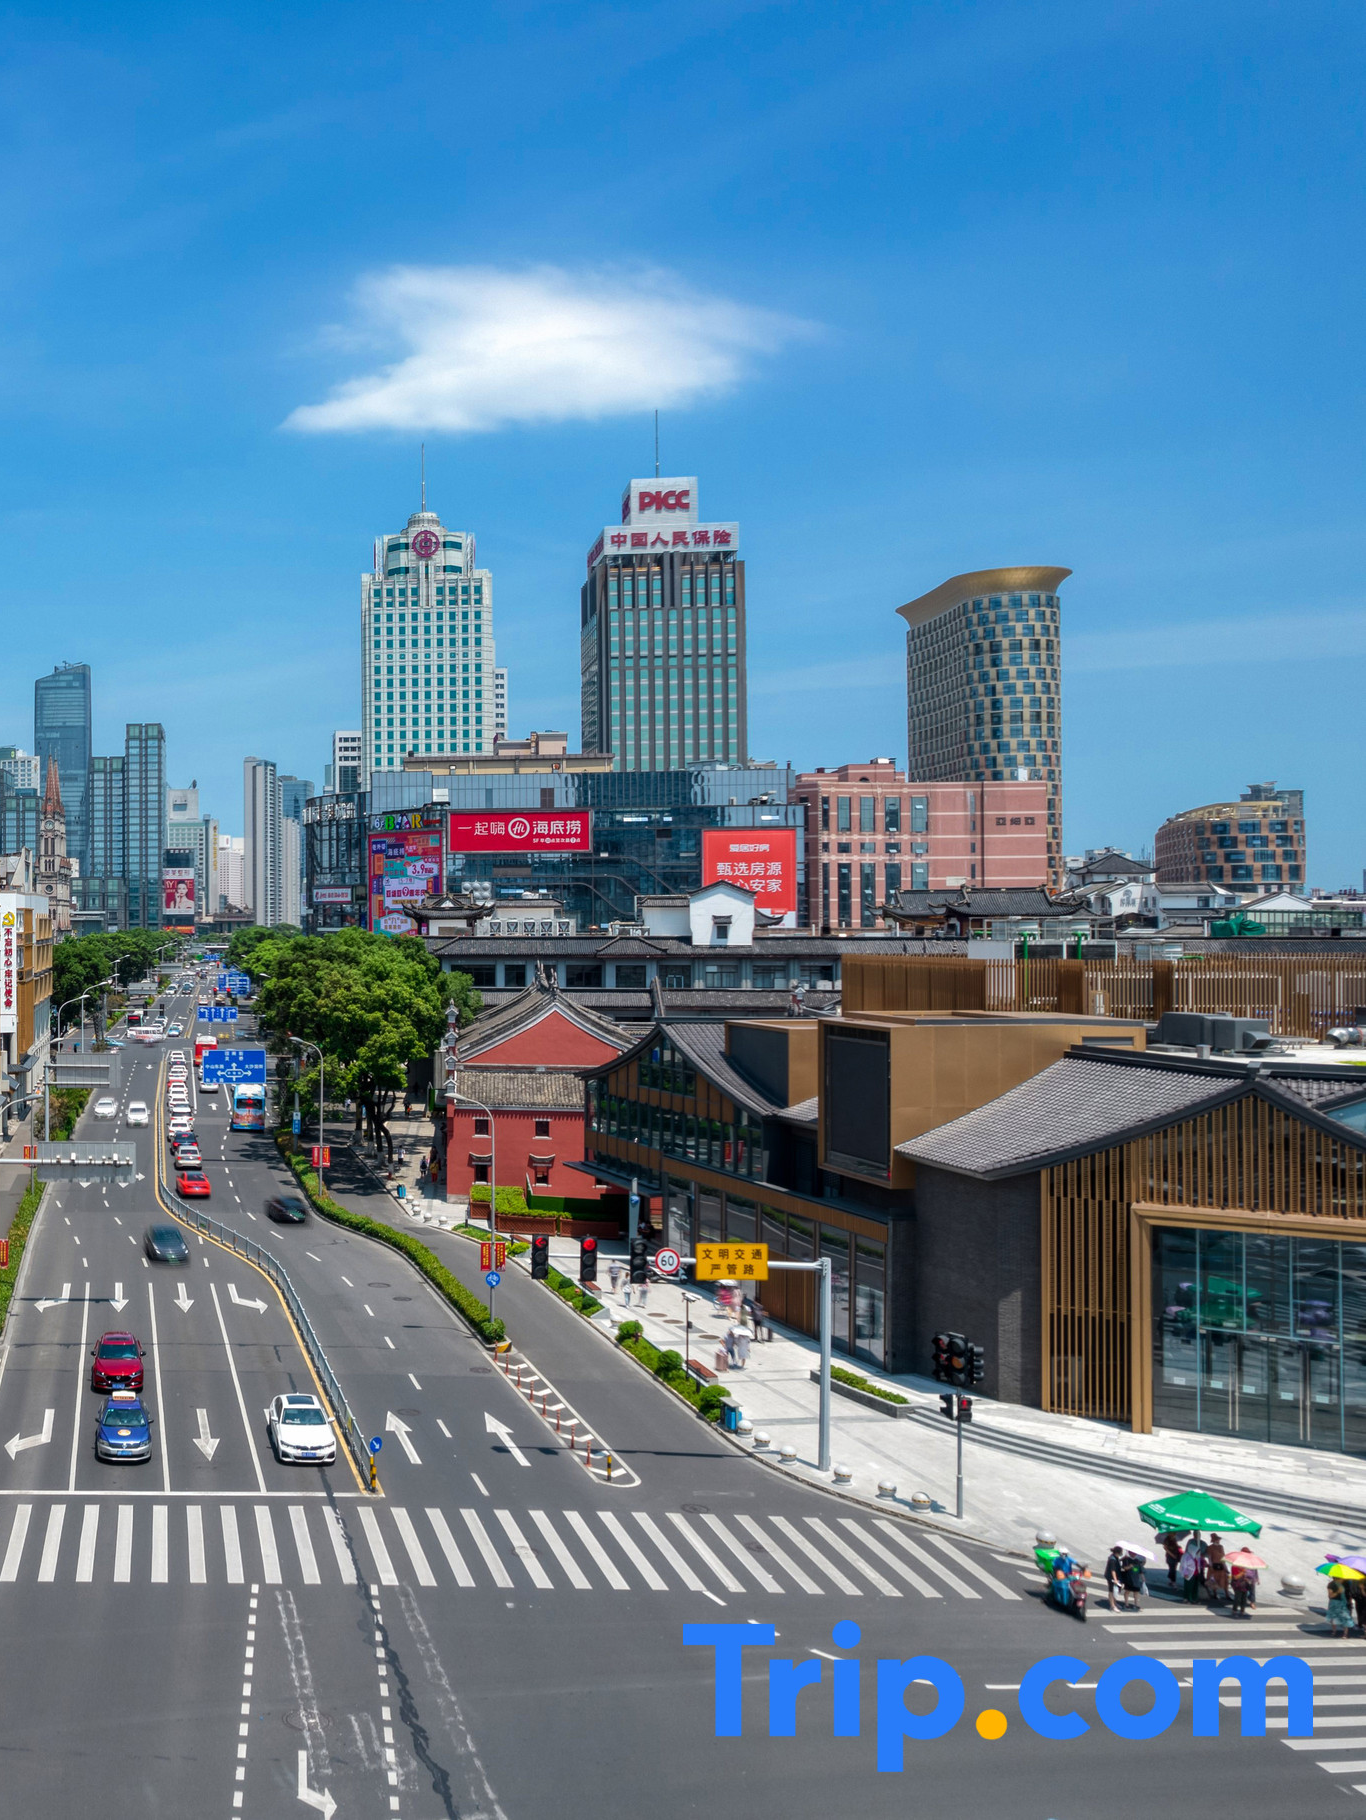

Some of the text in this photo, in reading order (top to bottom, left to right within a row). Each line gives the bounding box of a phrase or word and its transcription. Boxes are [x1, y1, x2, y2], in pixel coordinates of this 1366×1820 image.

[639, 490, 690, 511] PICC
[611, 530, 732, 548] 中国人民保险
[385, 813, 422, 830] BAR
[458, 821, 505, 835] 一起嗨
[533, 820, 581, 835] 海底捞
[717, 862, 782, 875] 甄选房源
[4, 928, 13, 967] 不忘初心
[4, 969, 13, 1009] 牢记使命
[660, 1255, 674, 1267] 60
[702, 1248, 762, 1260] 文明交通
[710, 1264, 754, 1275] 严管路
